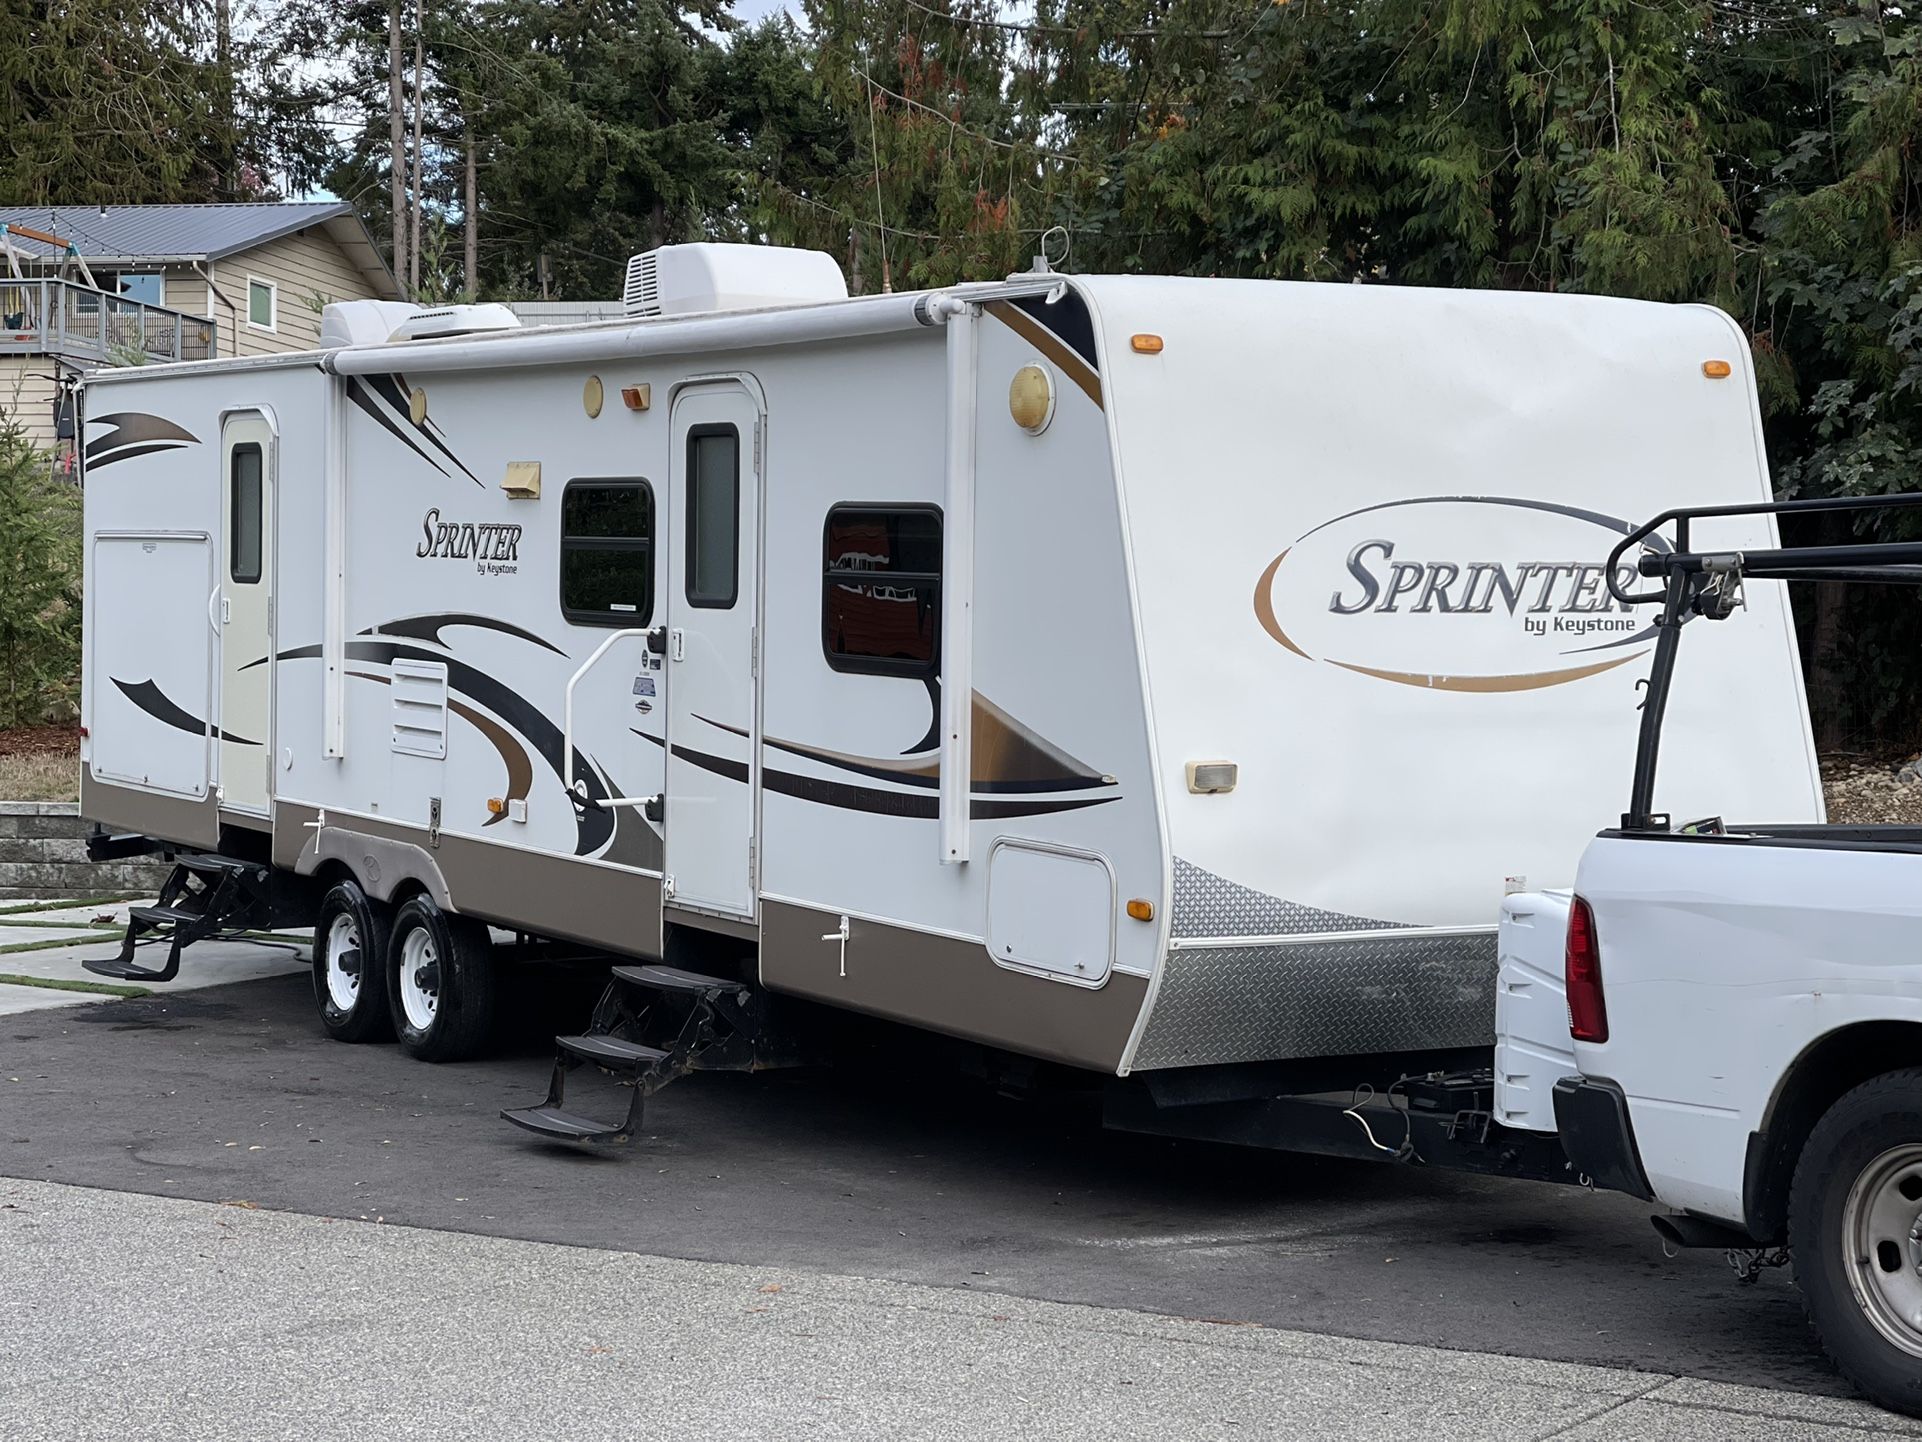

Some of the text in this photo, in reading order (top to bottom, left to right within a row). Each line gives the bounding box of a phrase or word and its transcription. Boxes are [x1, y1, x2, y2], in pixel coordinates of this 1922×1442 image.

[416, 507, 522, 561] SPRINTER
[477, 562, 518, 576] by Keystone
[1524, 616, 1636, 636] by Keystone
